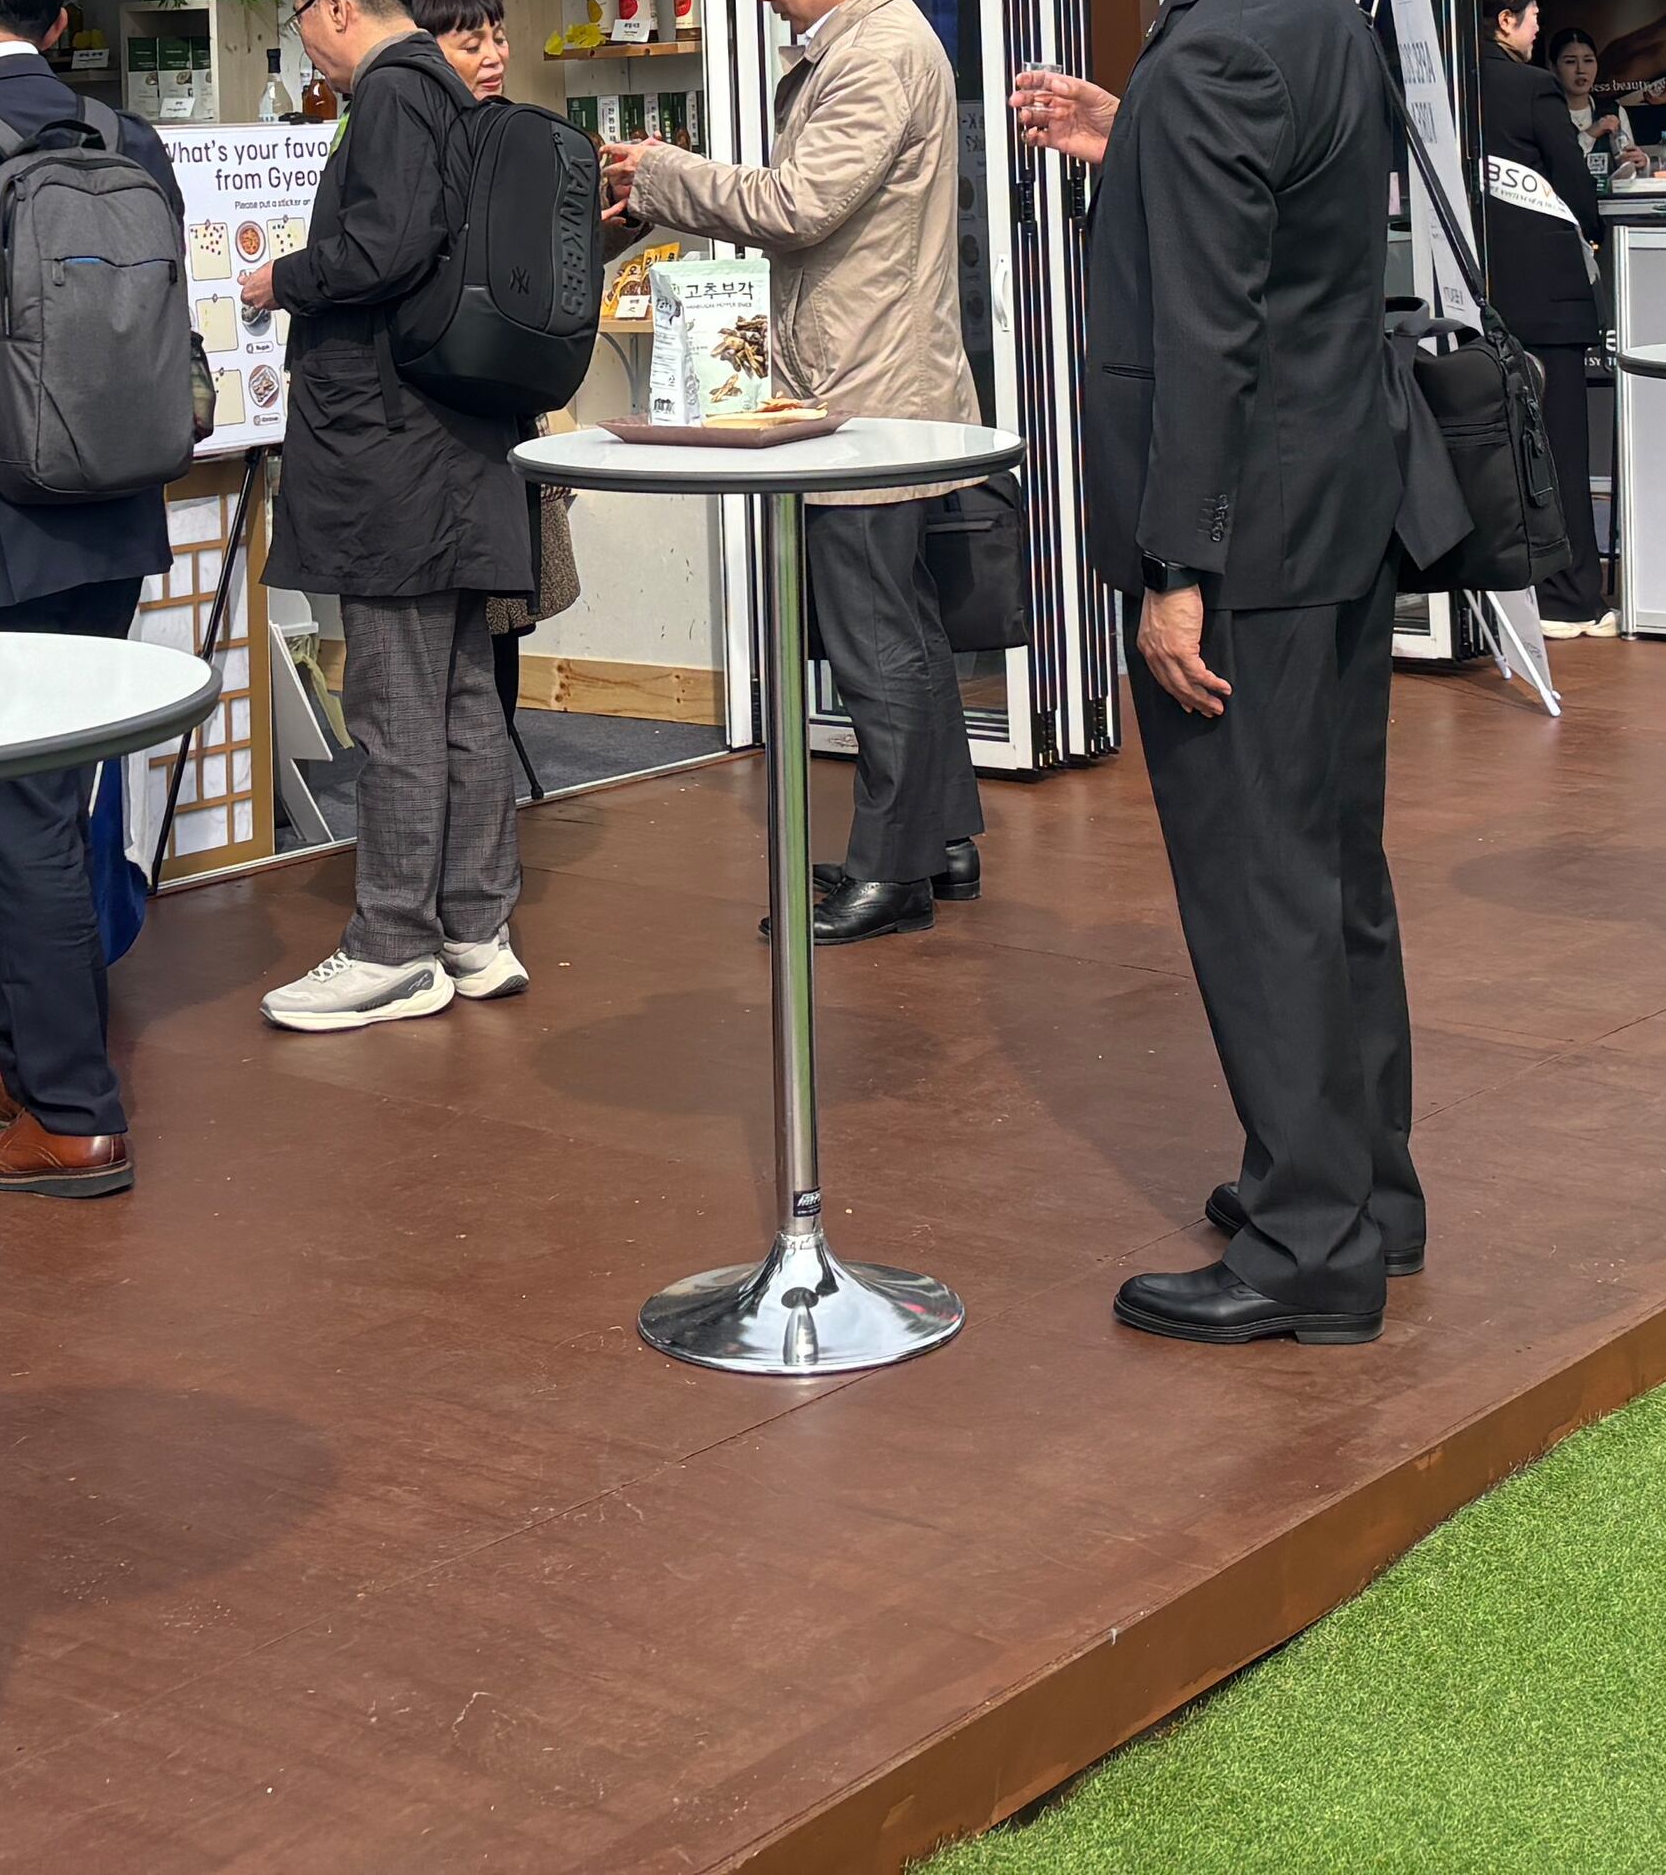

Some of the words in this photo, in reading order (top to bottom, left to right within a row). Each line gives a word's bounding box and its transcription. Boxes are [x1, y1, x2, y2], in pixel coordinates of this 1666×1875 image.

[234, 142, 279, 165] your
[284, 136, 329, 159] favo
[215, 168, 262, 191] from
[268, 166, 318, 191] Gyeo
[234, 201, 257, 210] Please
[559, 156, 594, 320] YANKEES
[684, 281, 755, 301] 고추부각
